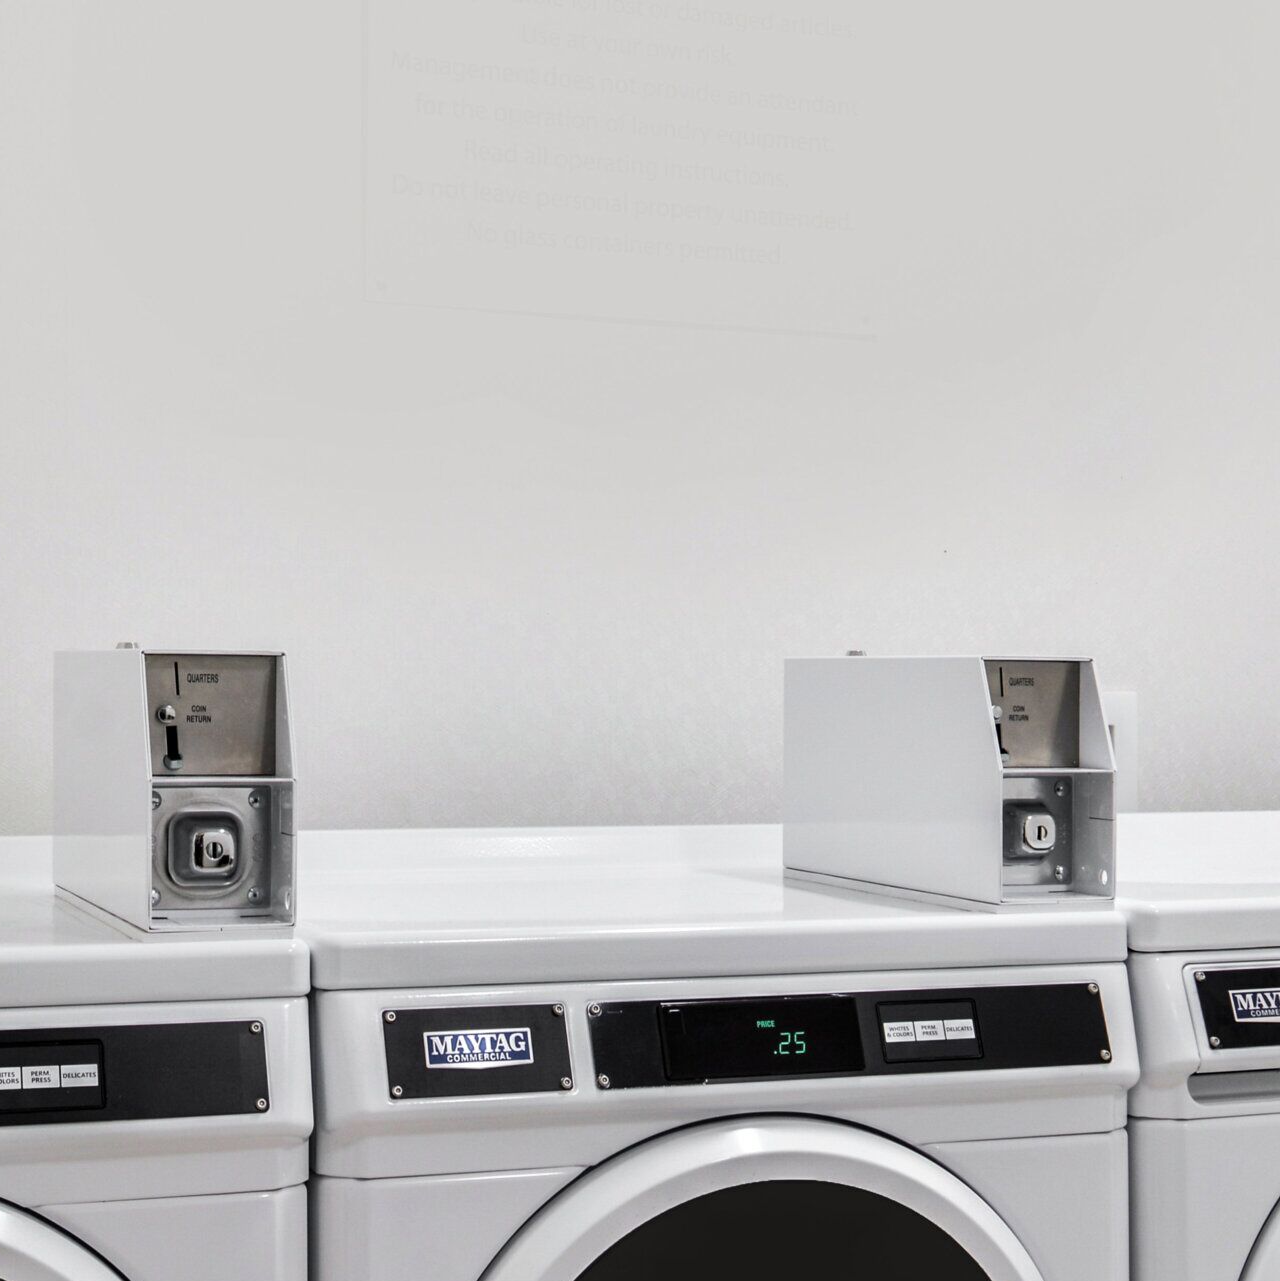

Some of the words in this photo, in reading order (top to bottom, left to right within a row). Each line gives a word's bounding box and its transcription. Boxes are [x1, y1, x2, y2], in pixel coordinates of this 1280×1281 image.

[677, 4, 774, 32] damaged
[778, 15, 857, 39] articles.
[521, 24, 561, 47] Use
[593, 36, 641, 57] your
[647, 42, 691, 61] own
[391, 50, 538, 83] Management
[544, 65, 595, 90] does
[602, 77, 640, 96] not
[643, 80, 721, 105] provide
[728, 88, 751, 106] an
[759, 93, 860, 118] attendant
[416, 92, 444, 116] for
[453, 96, 489, 120] the
[494, 105, 599, 130] operation
[606, 113, 628, 133] of
[632, 116, 711, 145] laundry
[716, 128, 836, 152] equipment.
[464, 138, 518, 163] Read
[525, 144, 548, 166] all
[554, 152, 659, 182] operating
[391, 173, 423, 196] Do
[431, 178, 466, 200] not
[473, 180, 530, 205] leave
[536, 190, 628, 213] personal
[633, 199, 723, 226] property
[731, 207, 856, 231] unattended.
[467, 220, 498, 243] No
[504, 225, 557, 249] glass
[563, 232, 674, 257] containers
[187, 673, 219, 683] QUARTERS
[1009, 677, 1034, 686] QUARTERS
[186, 715, 211, 723] RETURN
[756, 1020, 775, 1028] PRICE
[429, 1032, 526, 1056] MAYTAG
[447, 1052, 511, 1062] COMMERCIAL
[773, 1031, 806, 1054] .25
